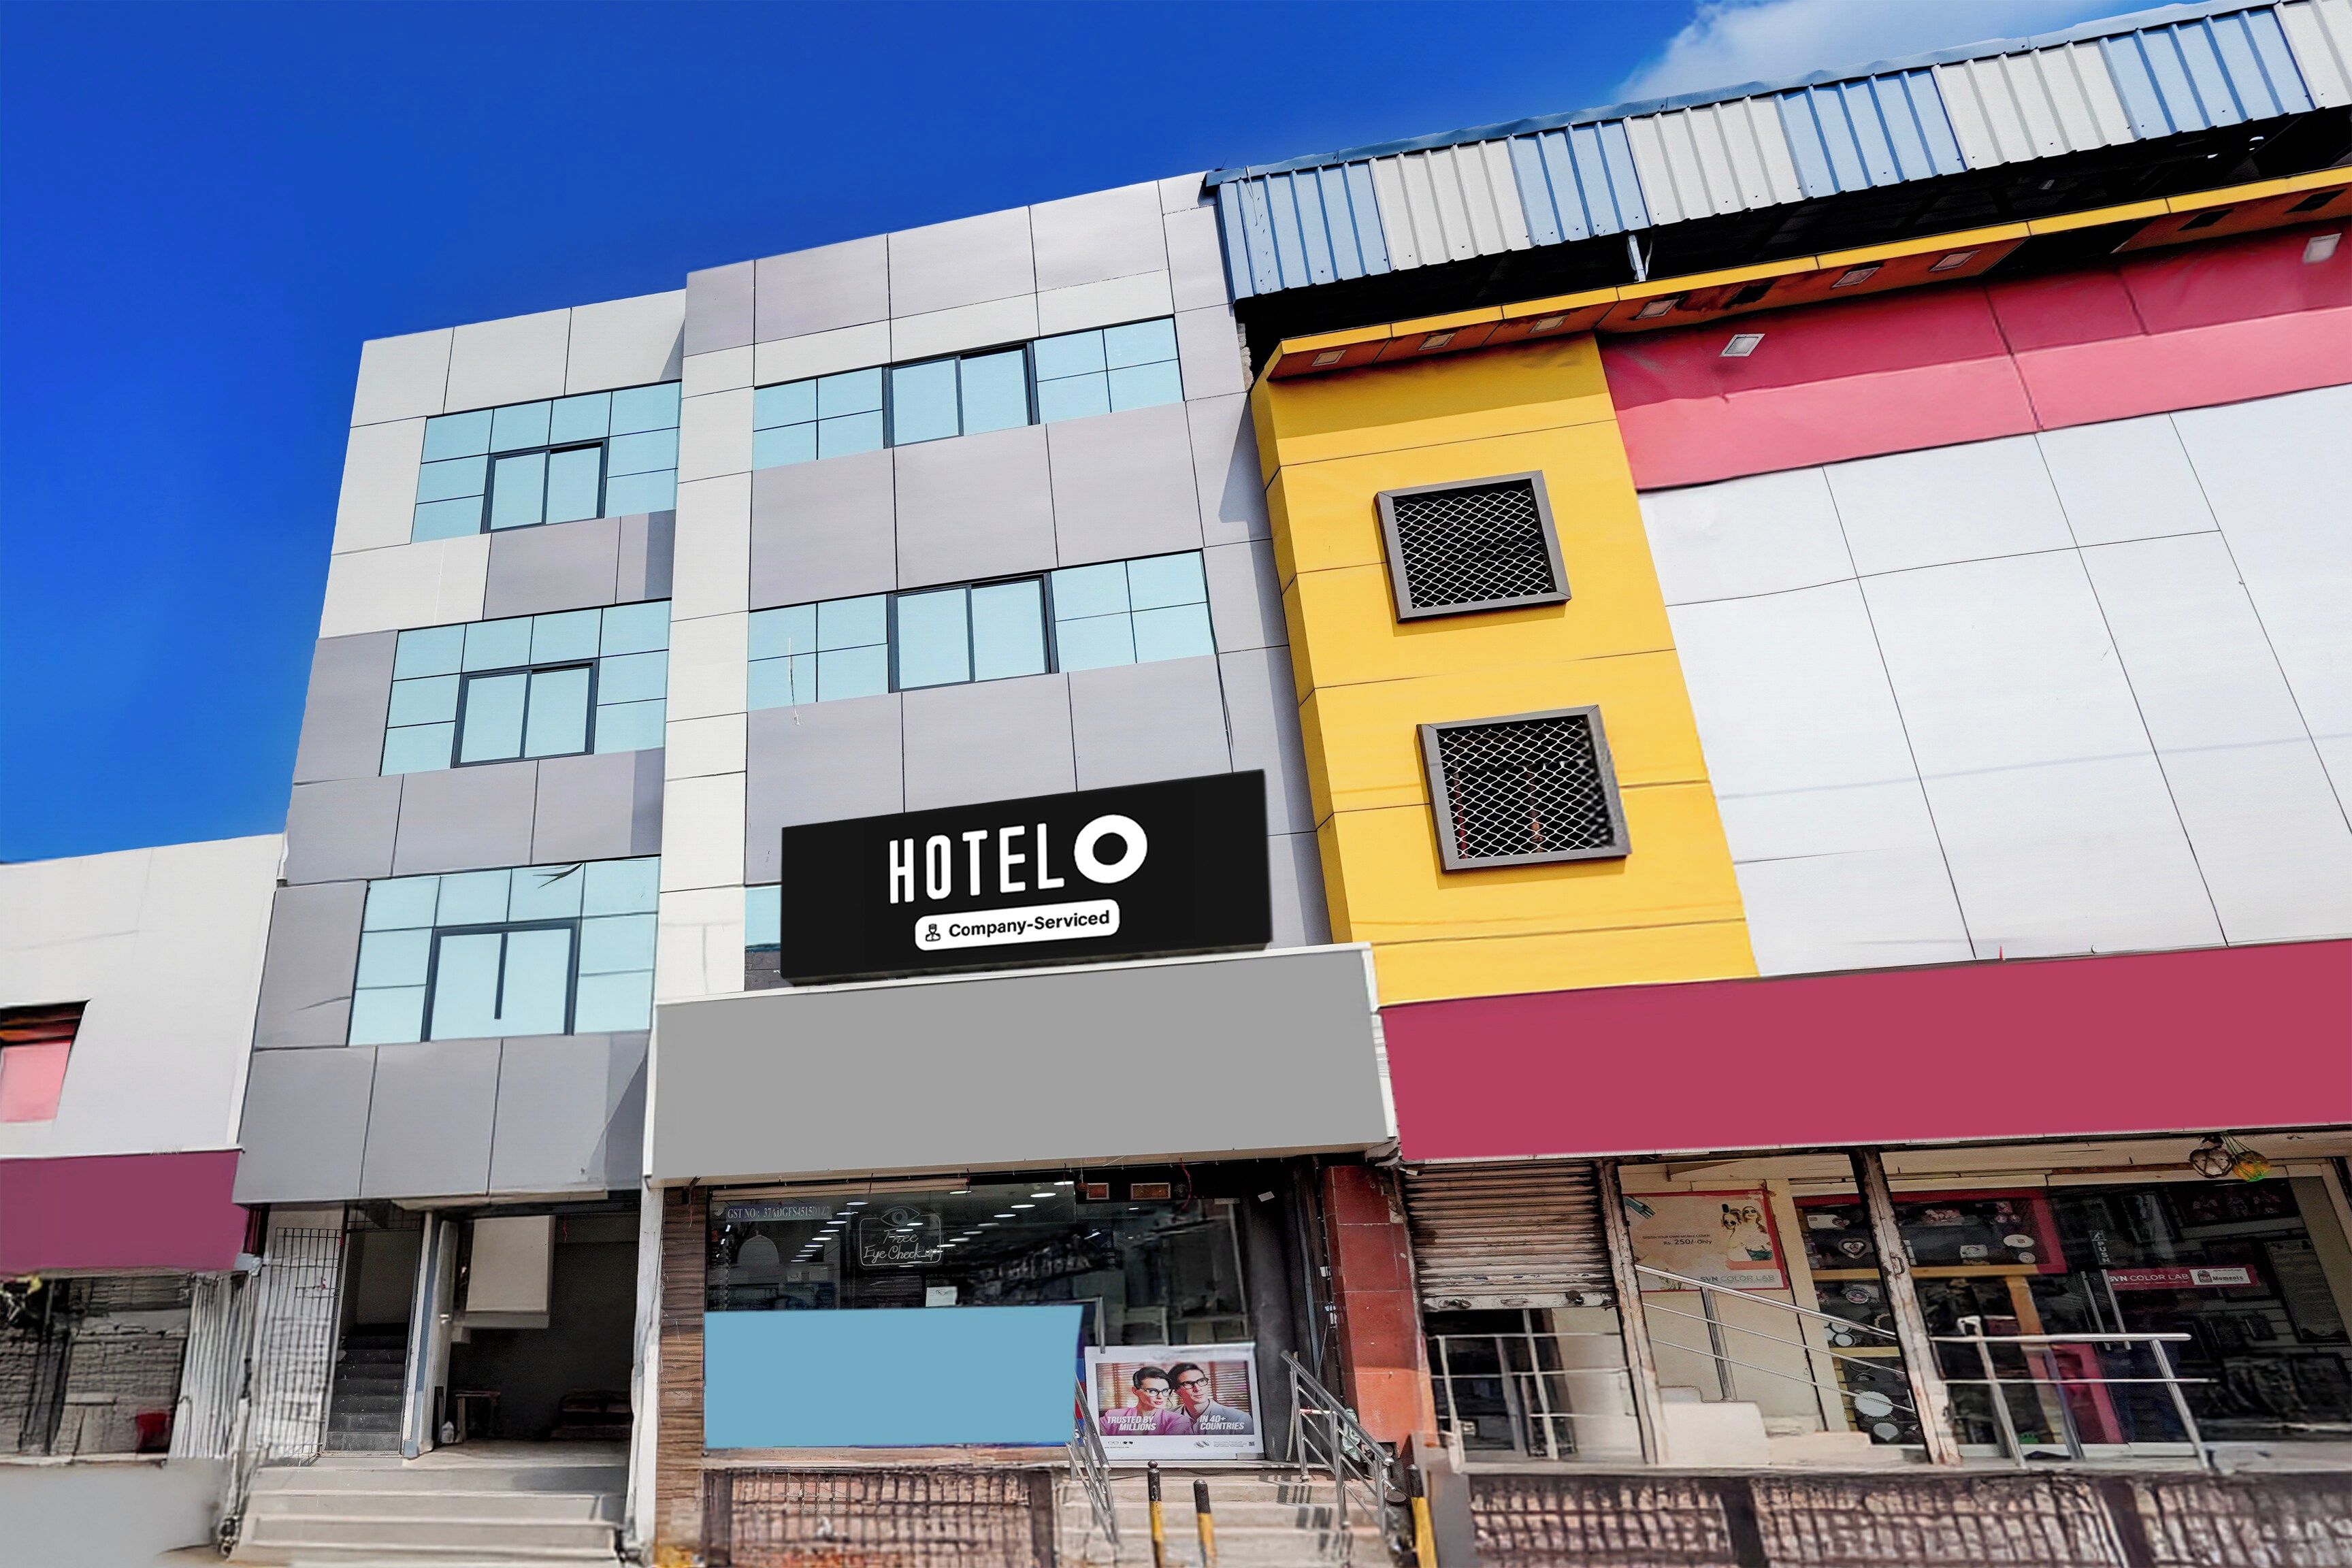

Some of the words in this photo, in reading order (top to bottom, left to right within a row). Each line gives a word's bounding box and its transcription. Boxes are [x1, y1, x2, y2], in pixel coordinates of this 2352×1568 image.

[889, 823, 1064, 904] HOTEL
[949, 910, 1111, 938] Company-Serviced
[728, 1209, 742, 1219] GST
[883, 1228, 919, 1244] Free
[863, 1244, 886, 1264] Eye
[887, 1243, 921, 1260] Check
[1119, 1423, 1156, 1431] MILLIONS
